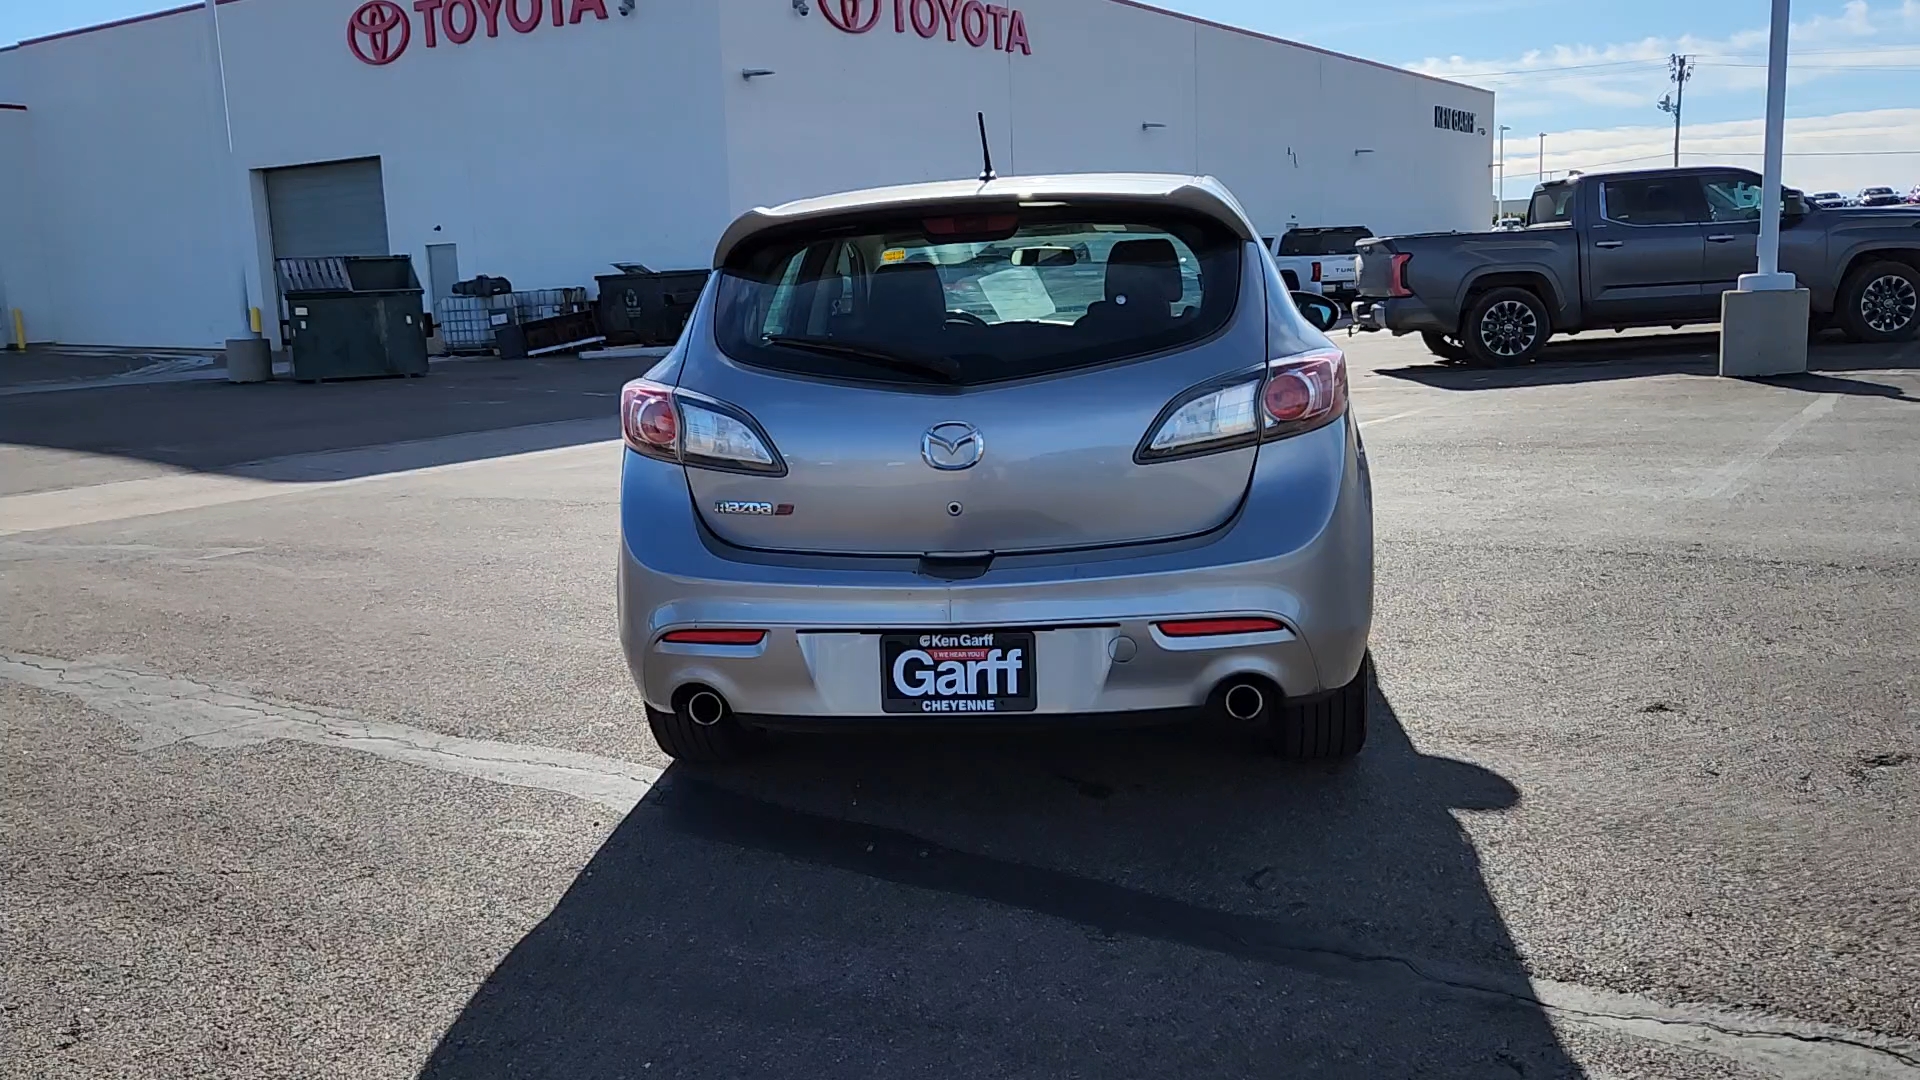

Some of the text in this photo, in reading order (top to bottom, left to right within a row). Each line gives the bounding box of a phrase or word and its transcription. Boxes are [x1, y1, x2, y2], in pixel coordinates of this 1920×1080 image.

[893, 0, 1032, 55] TOYOTA
[931, 634, 994, 647] Ken Garff
[893, 648, 1022, 696] Garff
[922, 700, 995, 711] CHEYENNE
